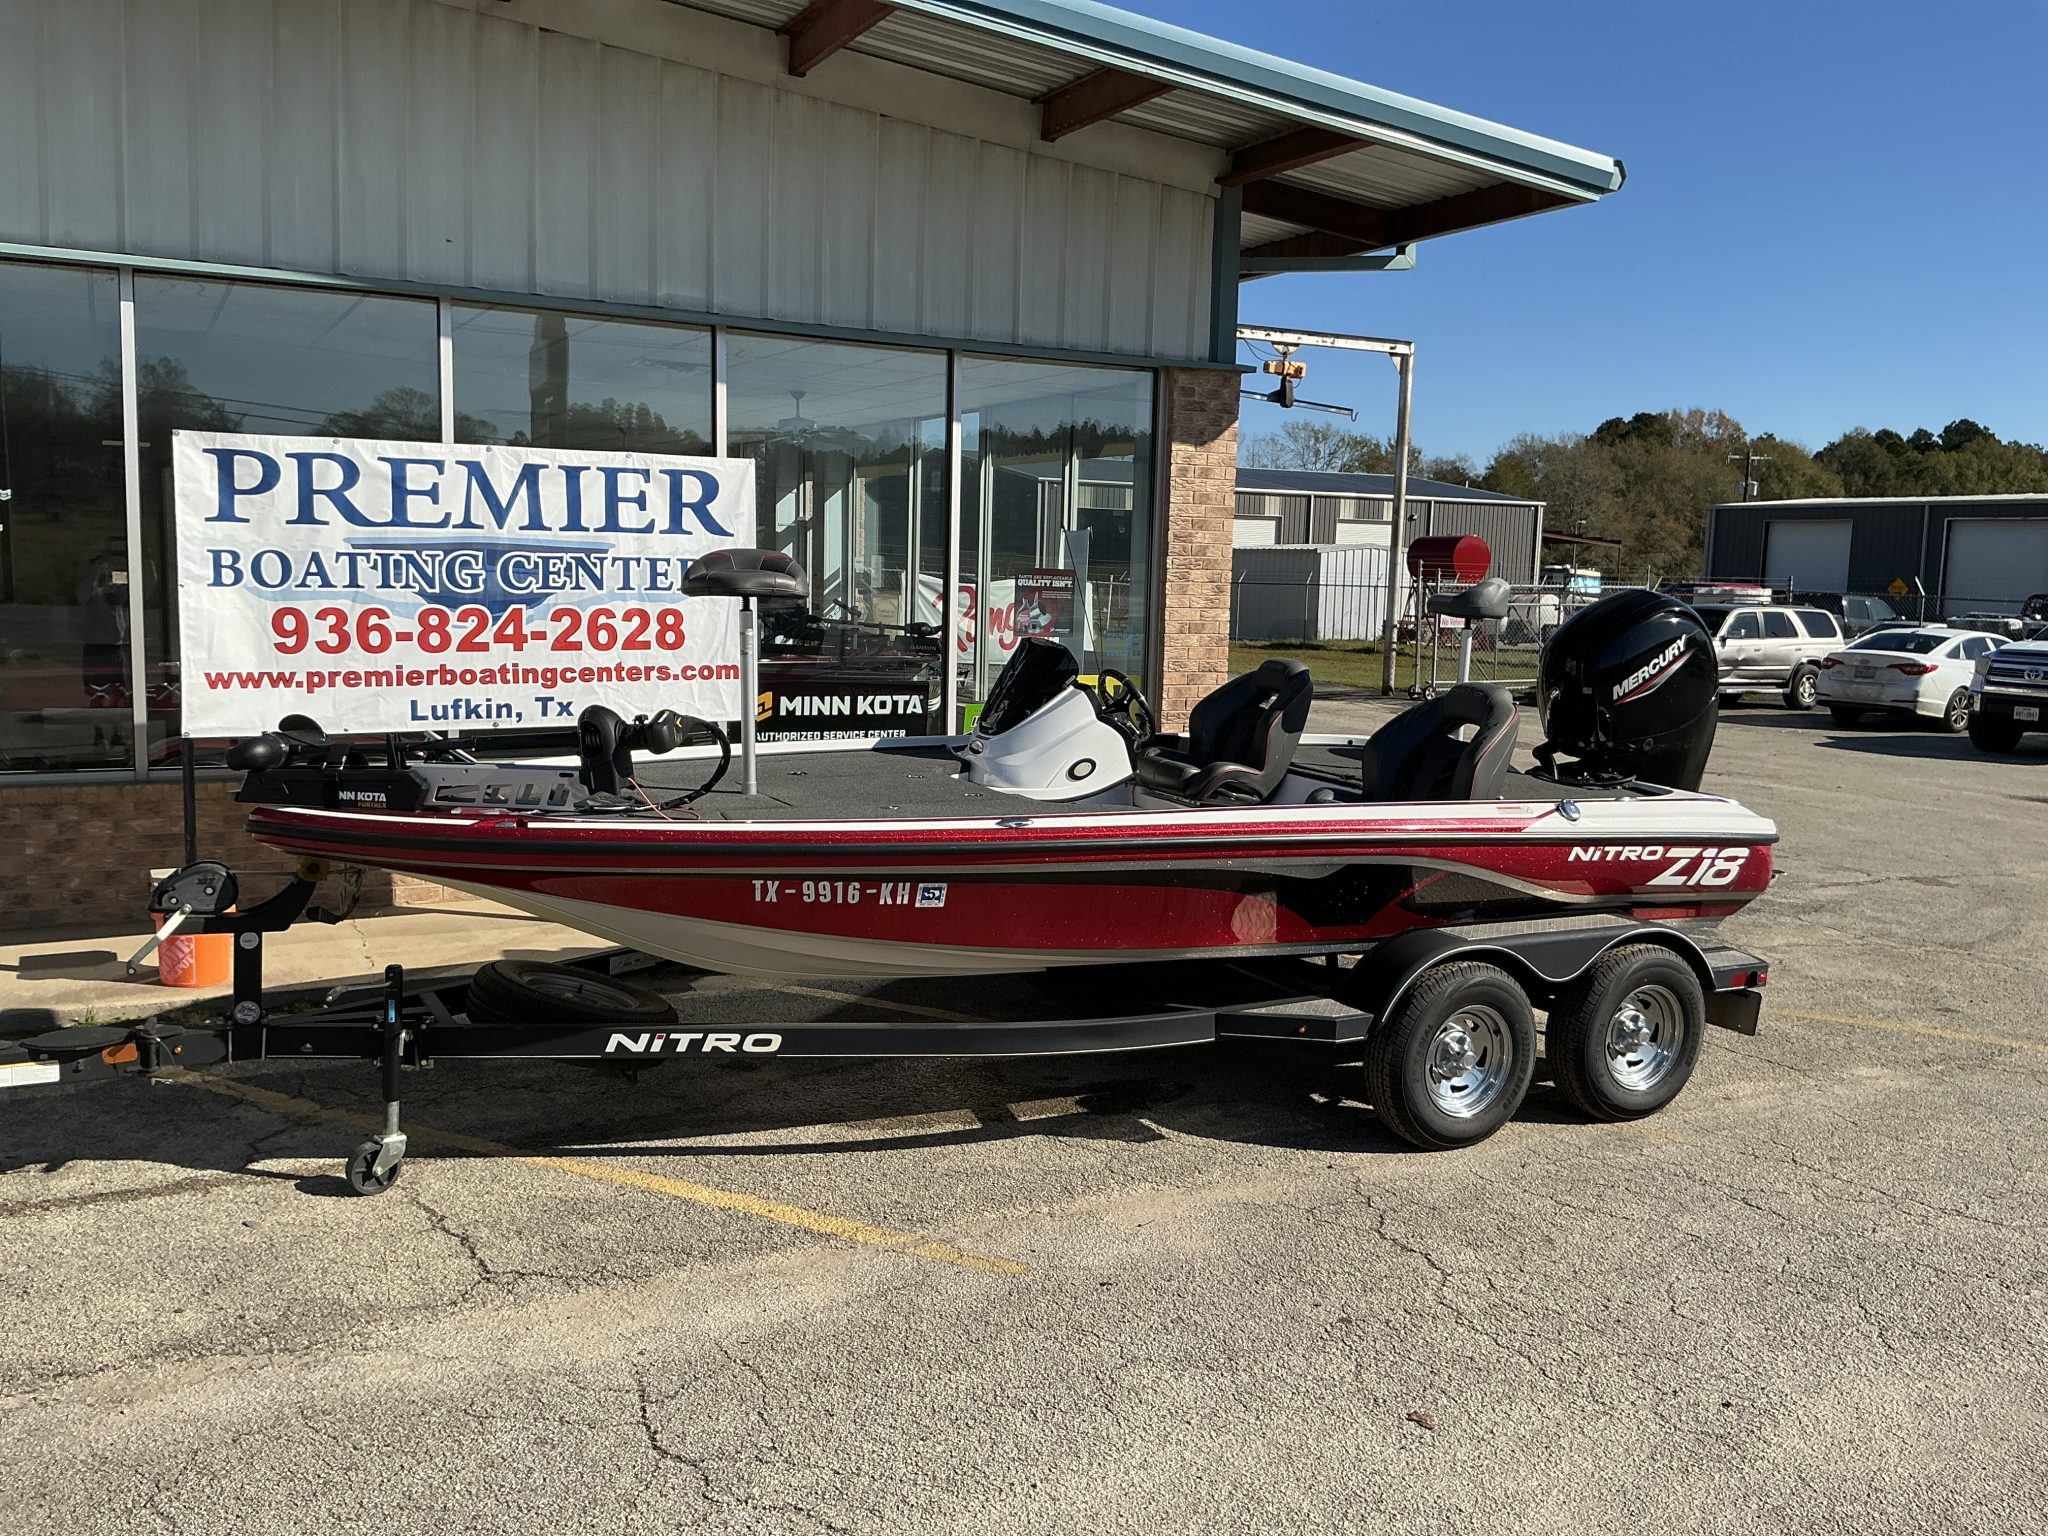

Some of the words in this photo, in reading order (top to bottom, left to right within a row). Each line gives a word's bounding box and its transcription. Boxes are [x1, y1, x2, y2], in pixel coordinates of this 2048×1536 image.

[202, 447, 734, 537] PREMIER
[207, 548, 485, 593] BOATING
[271, 606, 686, 655] 936-824-2628
[204, 662, 740, 693] www.premierboatingcenters.com
[1613, 634, 1687, 700] MERCURY
[410, 697, 523, 723] Lufkin,
[535, 696, 575, 718] Tx
[779, 695, 850, 716] MINN
[857, 694, 923, 715] KOTA
[823, 730, 866, 740] SERVICE
[867, 729, 906, 738] CENTER
[357, 791, 387, 801] KOTA
[1646, 847, 1750, 886] Z18
